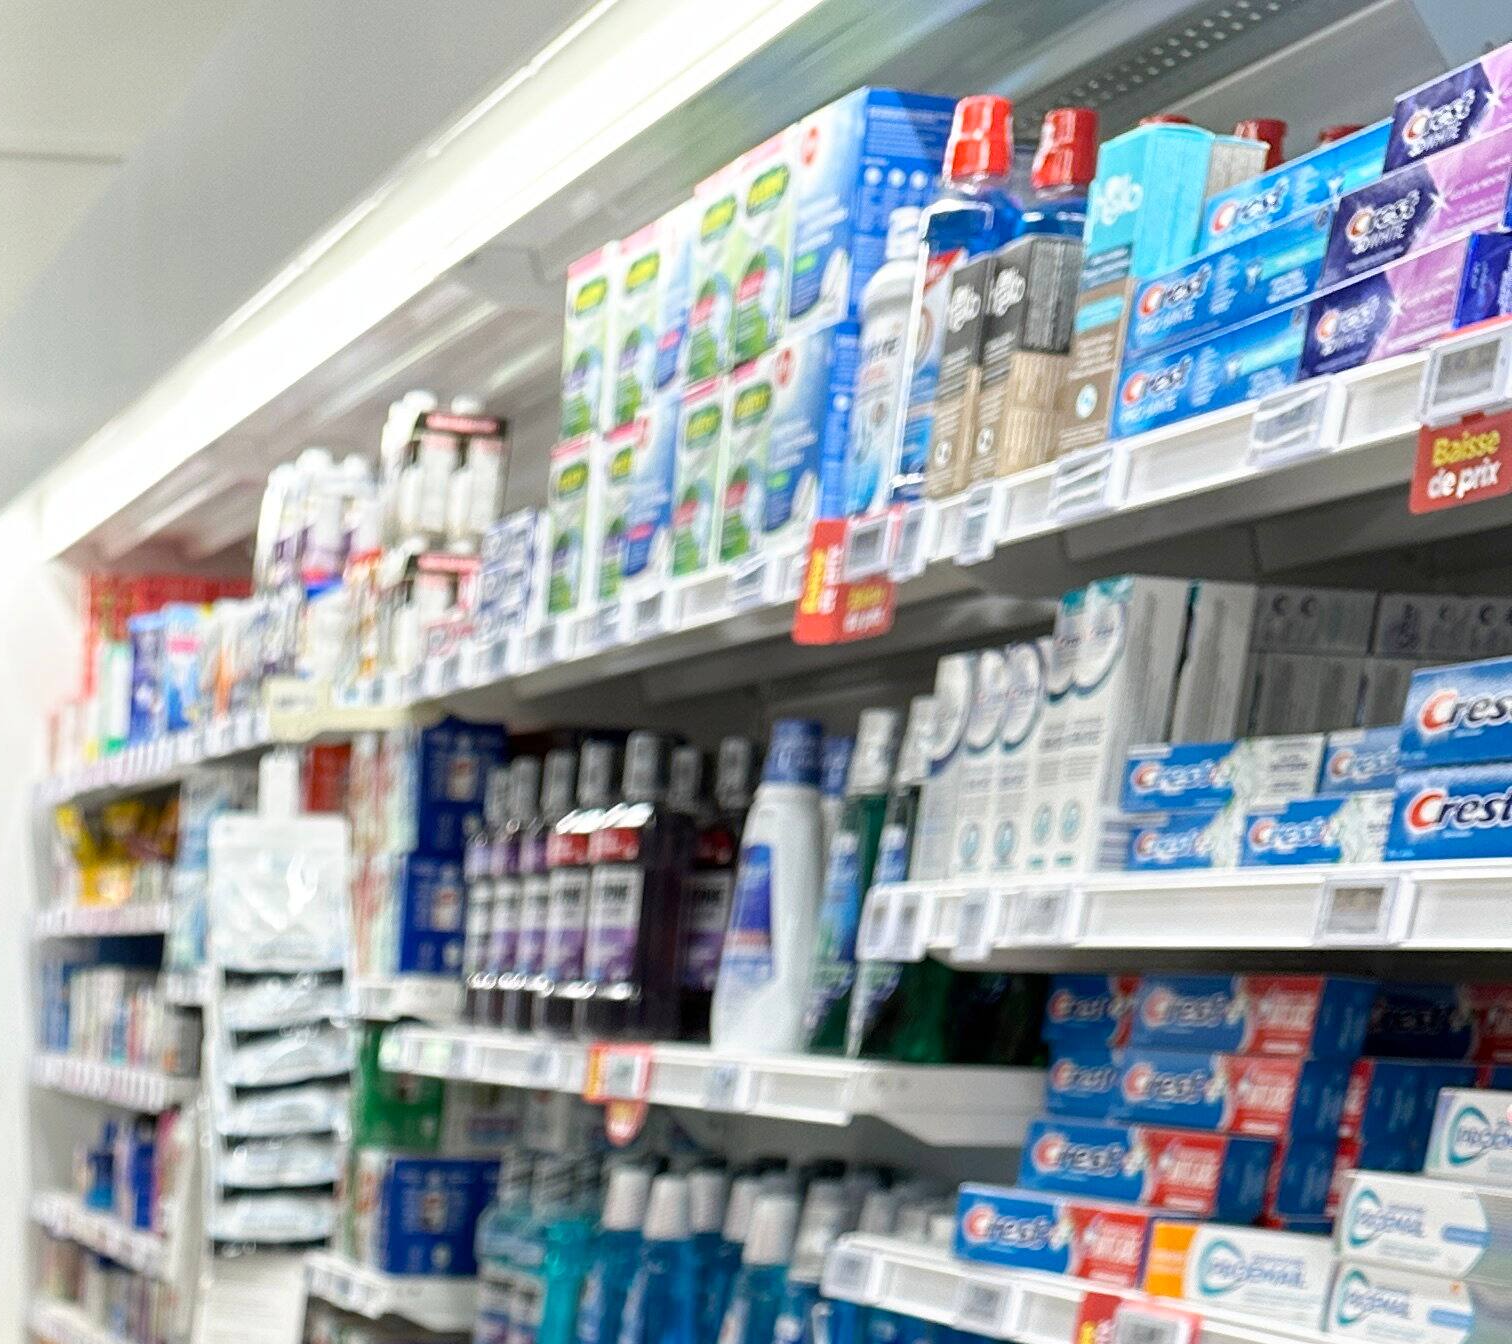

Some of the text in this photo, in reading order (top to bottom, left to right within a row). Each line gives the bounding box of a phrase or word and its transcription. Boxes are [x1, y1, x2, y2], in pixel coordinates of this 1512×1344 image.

[1432, 430, 1501, 467] Baisse
[1427, 456, 1503, 499] de prix
[1420, 688, 1512, 734] Cres
